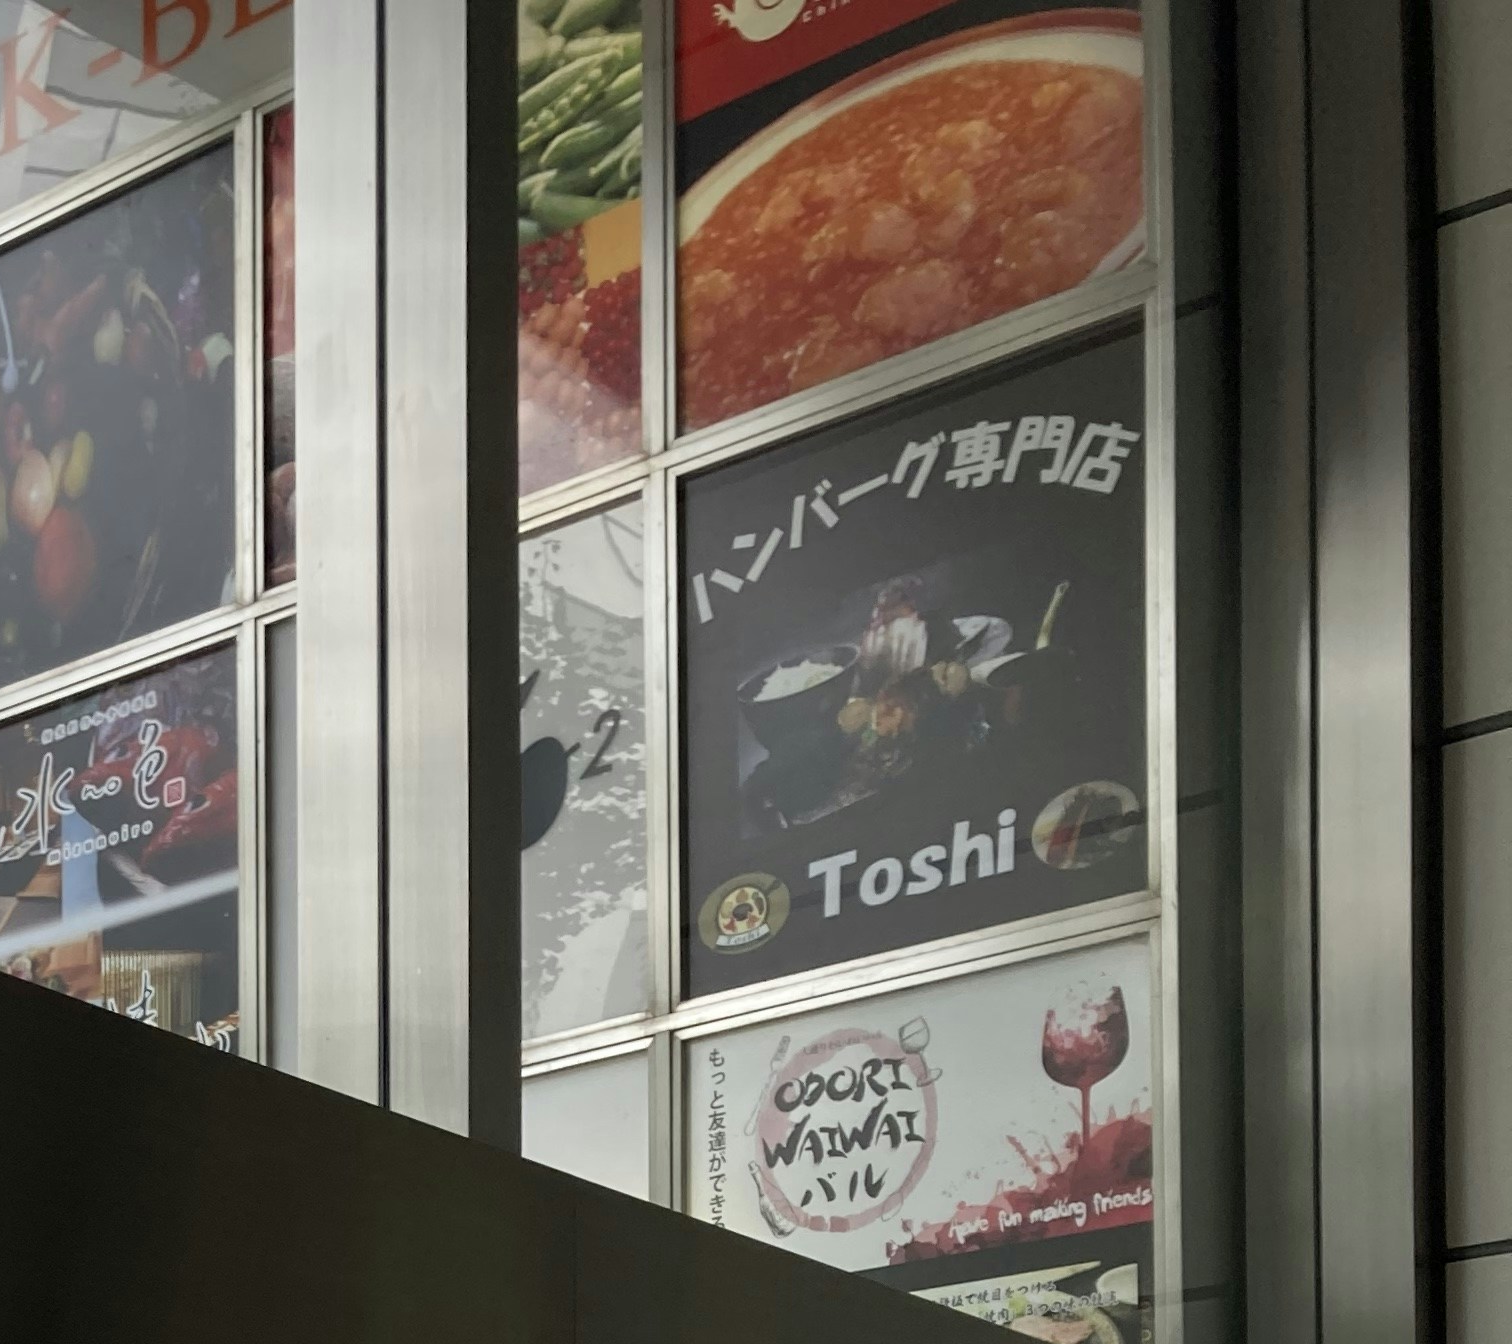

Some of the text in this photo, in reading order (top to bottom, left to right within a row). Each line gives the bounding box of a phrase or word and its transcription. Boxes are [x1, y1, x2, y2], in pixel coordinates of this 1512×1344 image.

[693, 414, 1141, 624] ハンバーグ専門店
[807, 808, 1017, 919] Toshi
[775, 1058, 912, 1112] ODORI
[762, 1098, 926, 1170] WAIWAI
[801, 1163, 889, 1207] バル
